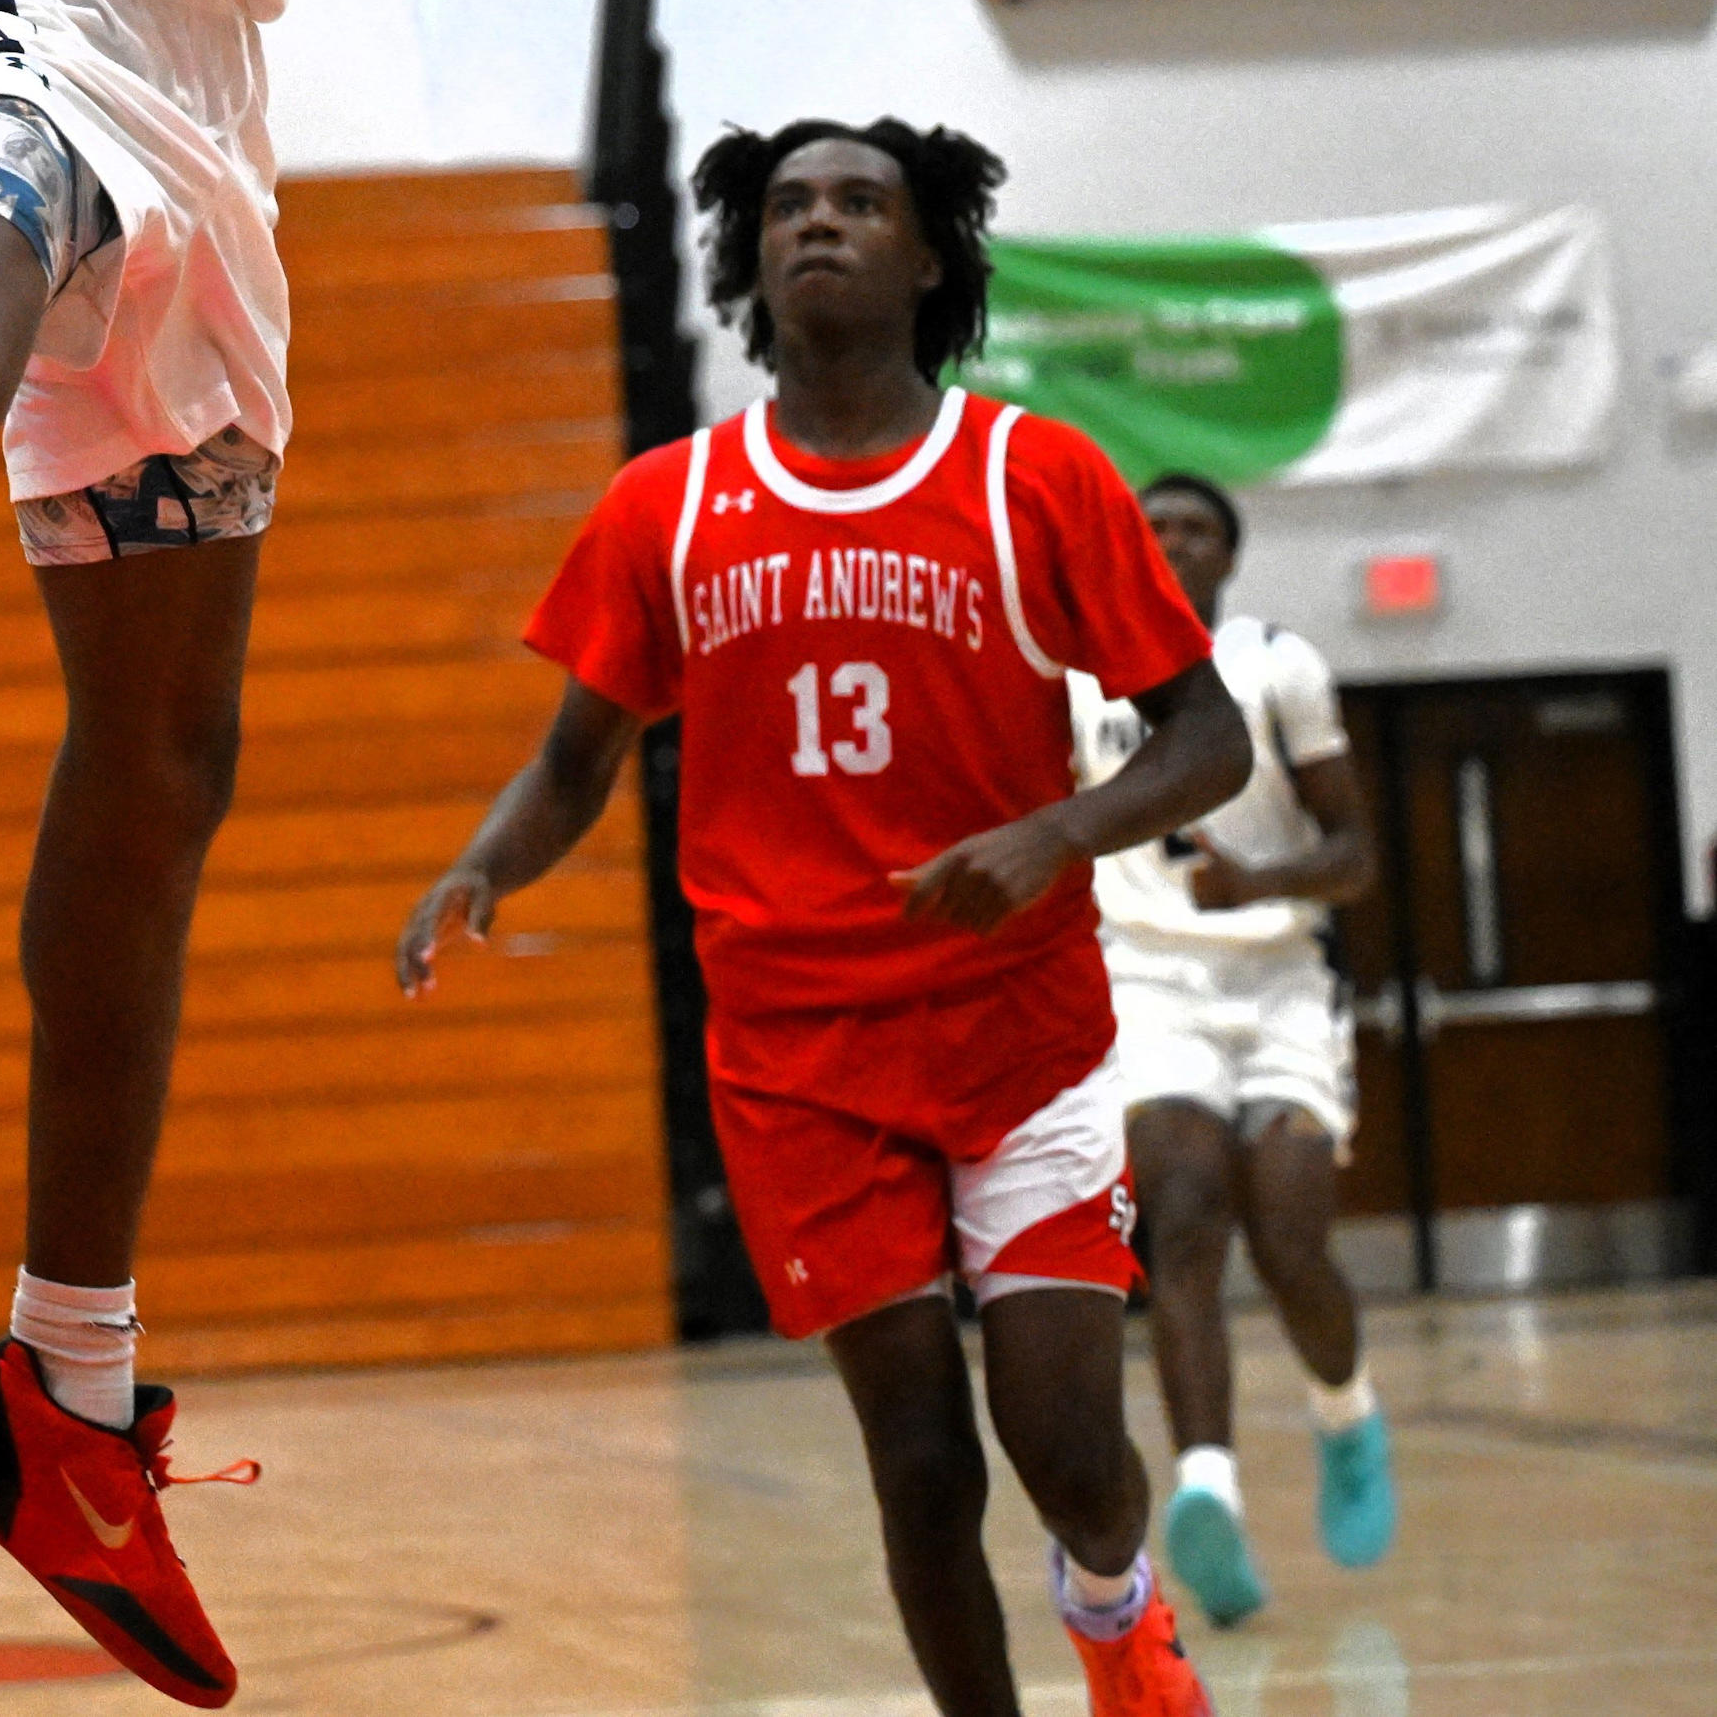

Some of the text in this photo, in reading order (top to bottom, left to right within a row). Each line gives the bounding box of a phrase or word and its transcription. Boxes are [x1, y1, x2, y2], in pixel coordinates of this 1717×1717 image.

[693, 548, 983, 654] SAINT ANDREW'S
[787, 662, 893, 777] 13
